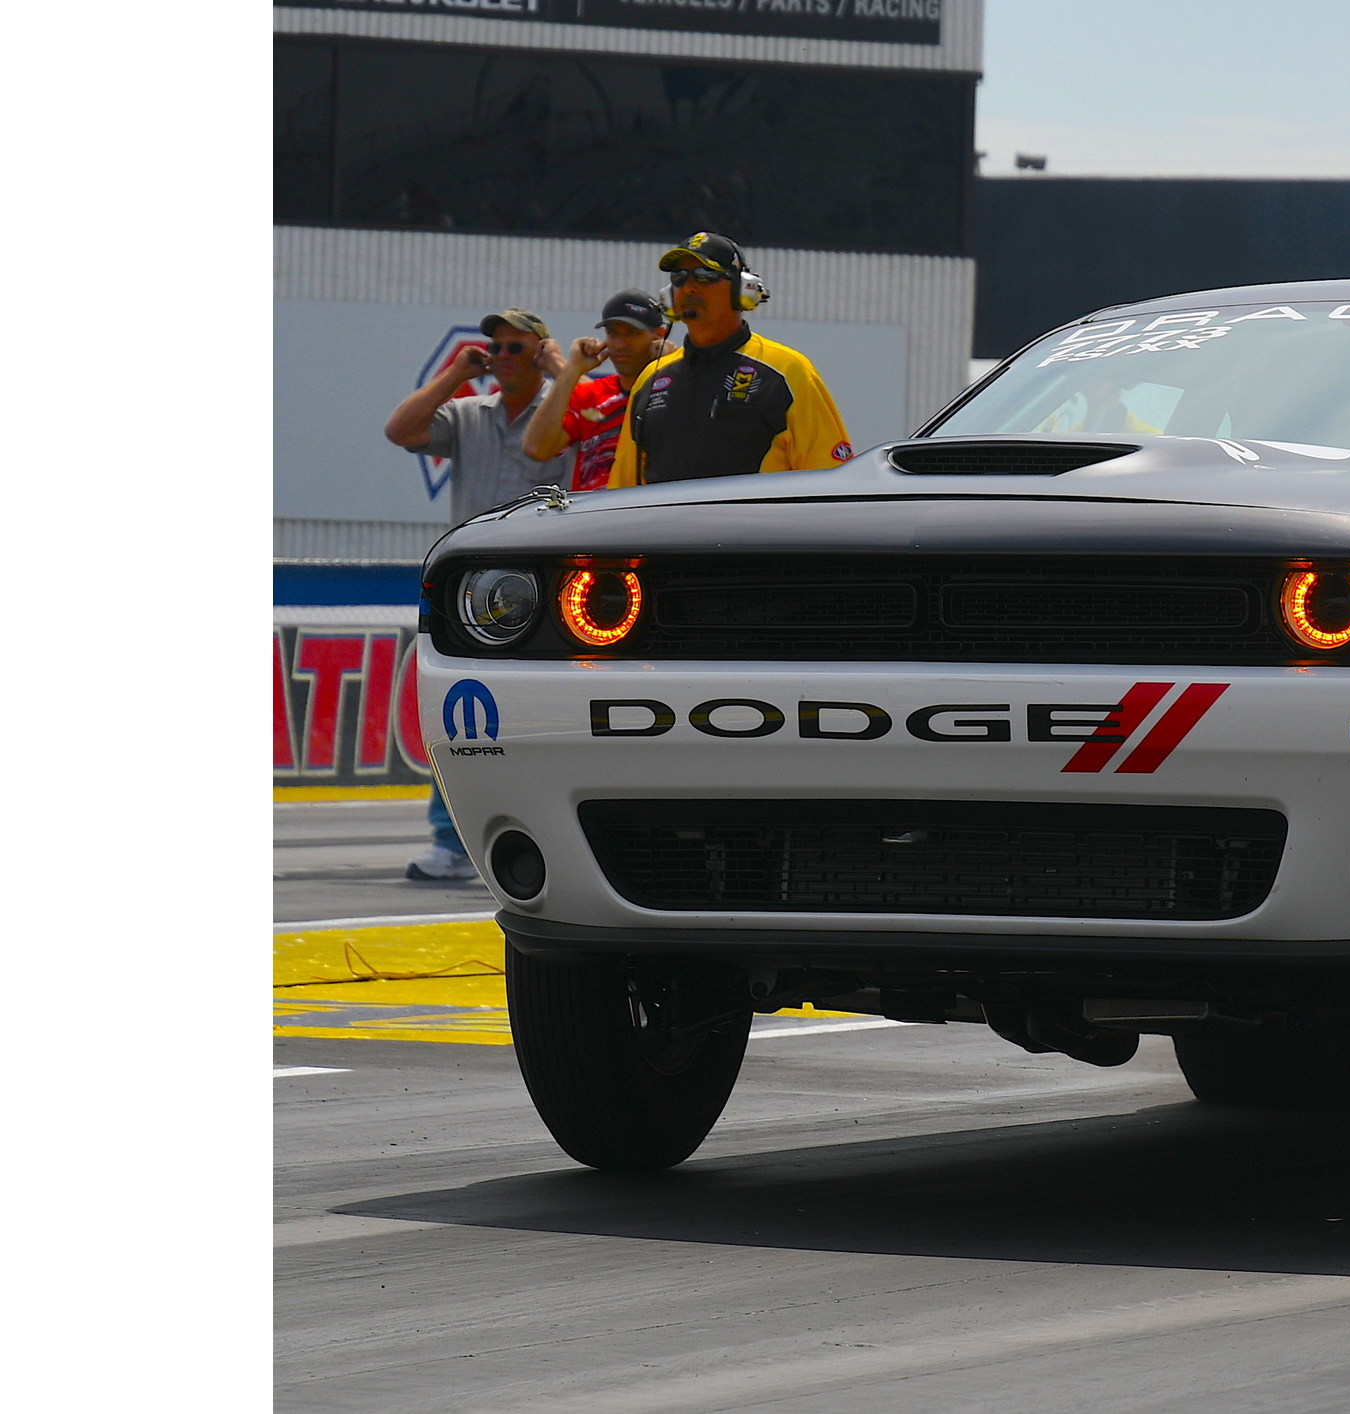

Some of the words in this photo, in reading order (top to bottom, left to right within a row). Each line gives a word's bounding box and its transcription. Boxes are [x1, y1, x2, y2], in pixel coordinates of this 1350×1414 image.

[854, 0, 941, 19] RACING
[1036, 338, 1210, 369] FS/XX
[589, 698, 1126, 742] DODGE
[449, 747, 505, 756] MOPAR
